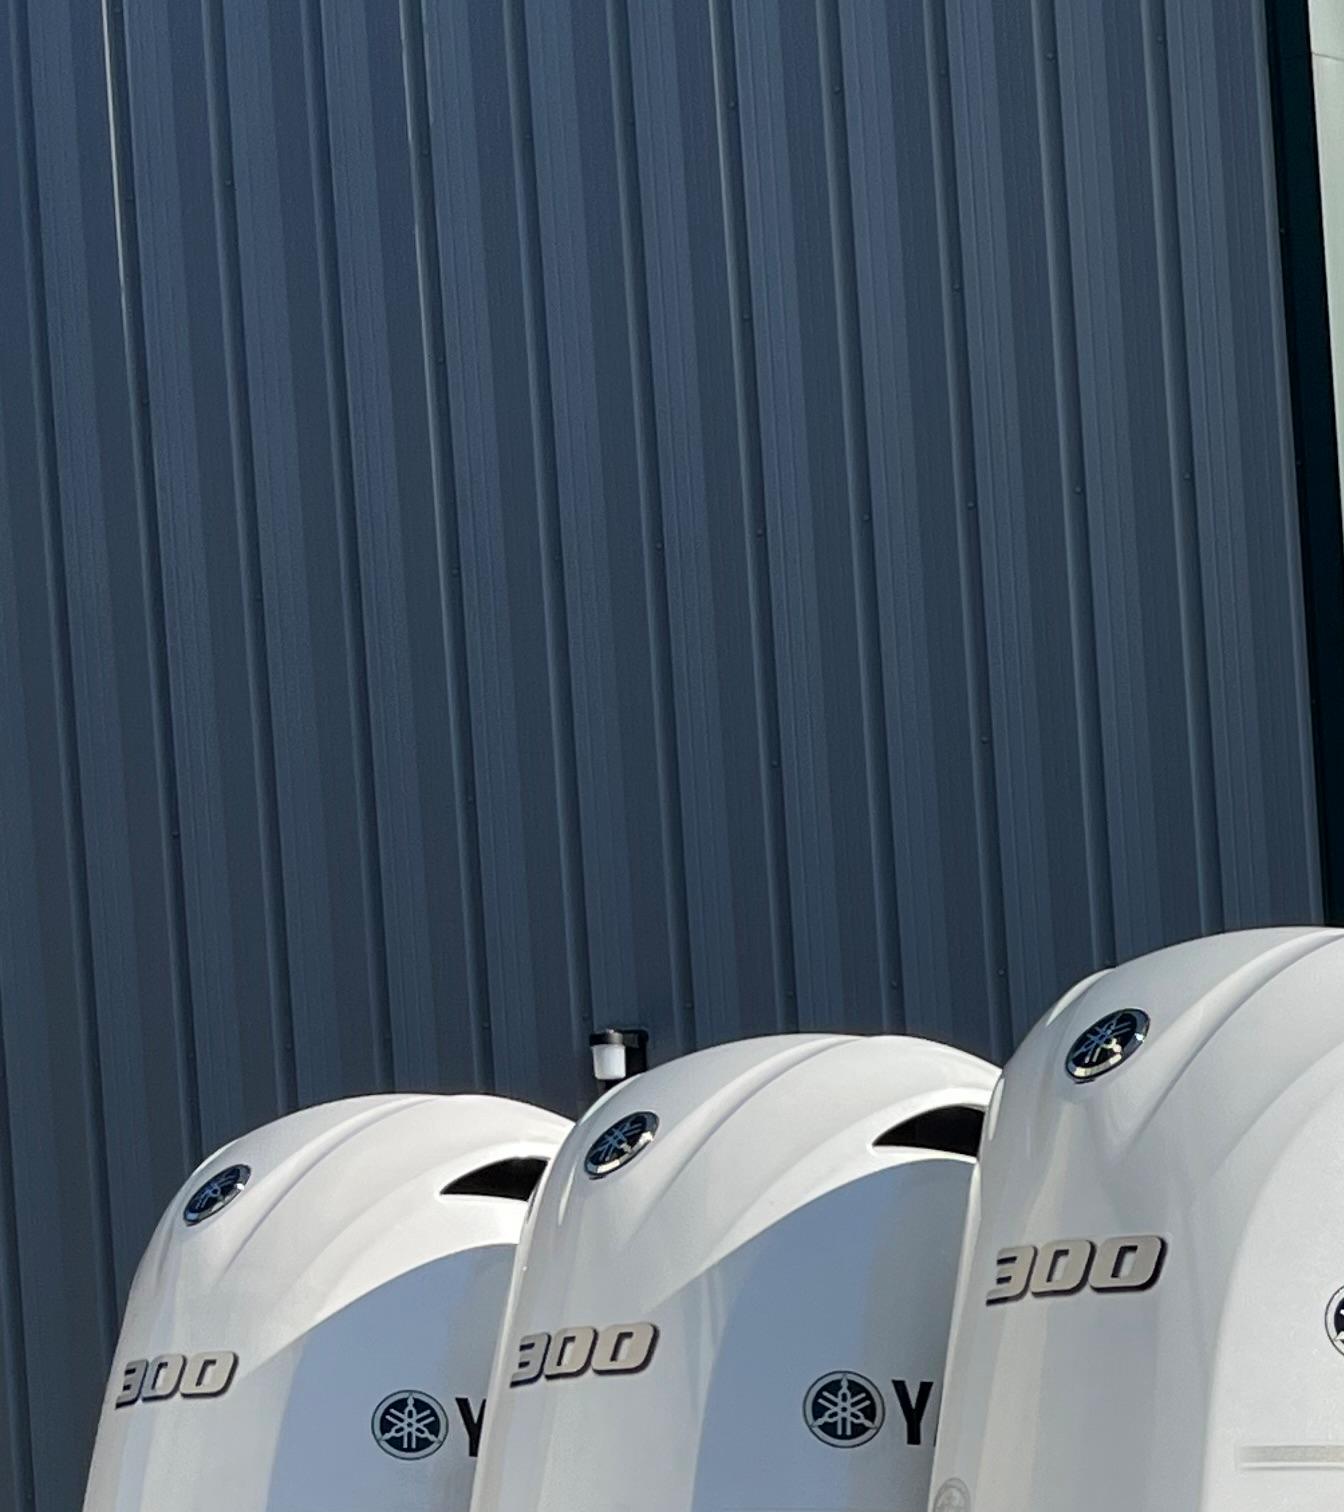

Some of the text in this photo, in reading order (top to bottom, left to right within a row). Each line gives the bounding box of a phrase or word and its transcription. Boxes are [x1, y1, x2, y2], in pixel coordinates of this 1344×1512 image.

[986, 1234, 1168, 1307] 300
[114, 1351, 239, 1410] 300
[509, 1322, 660, 1389] 300
[891, 1379, 937, 1447] Y
